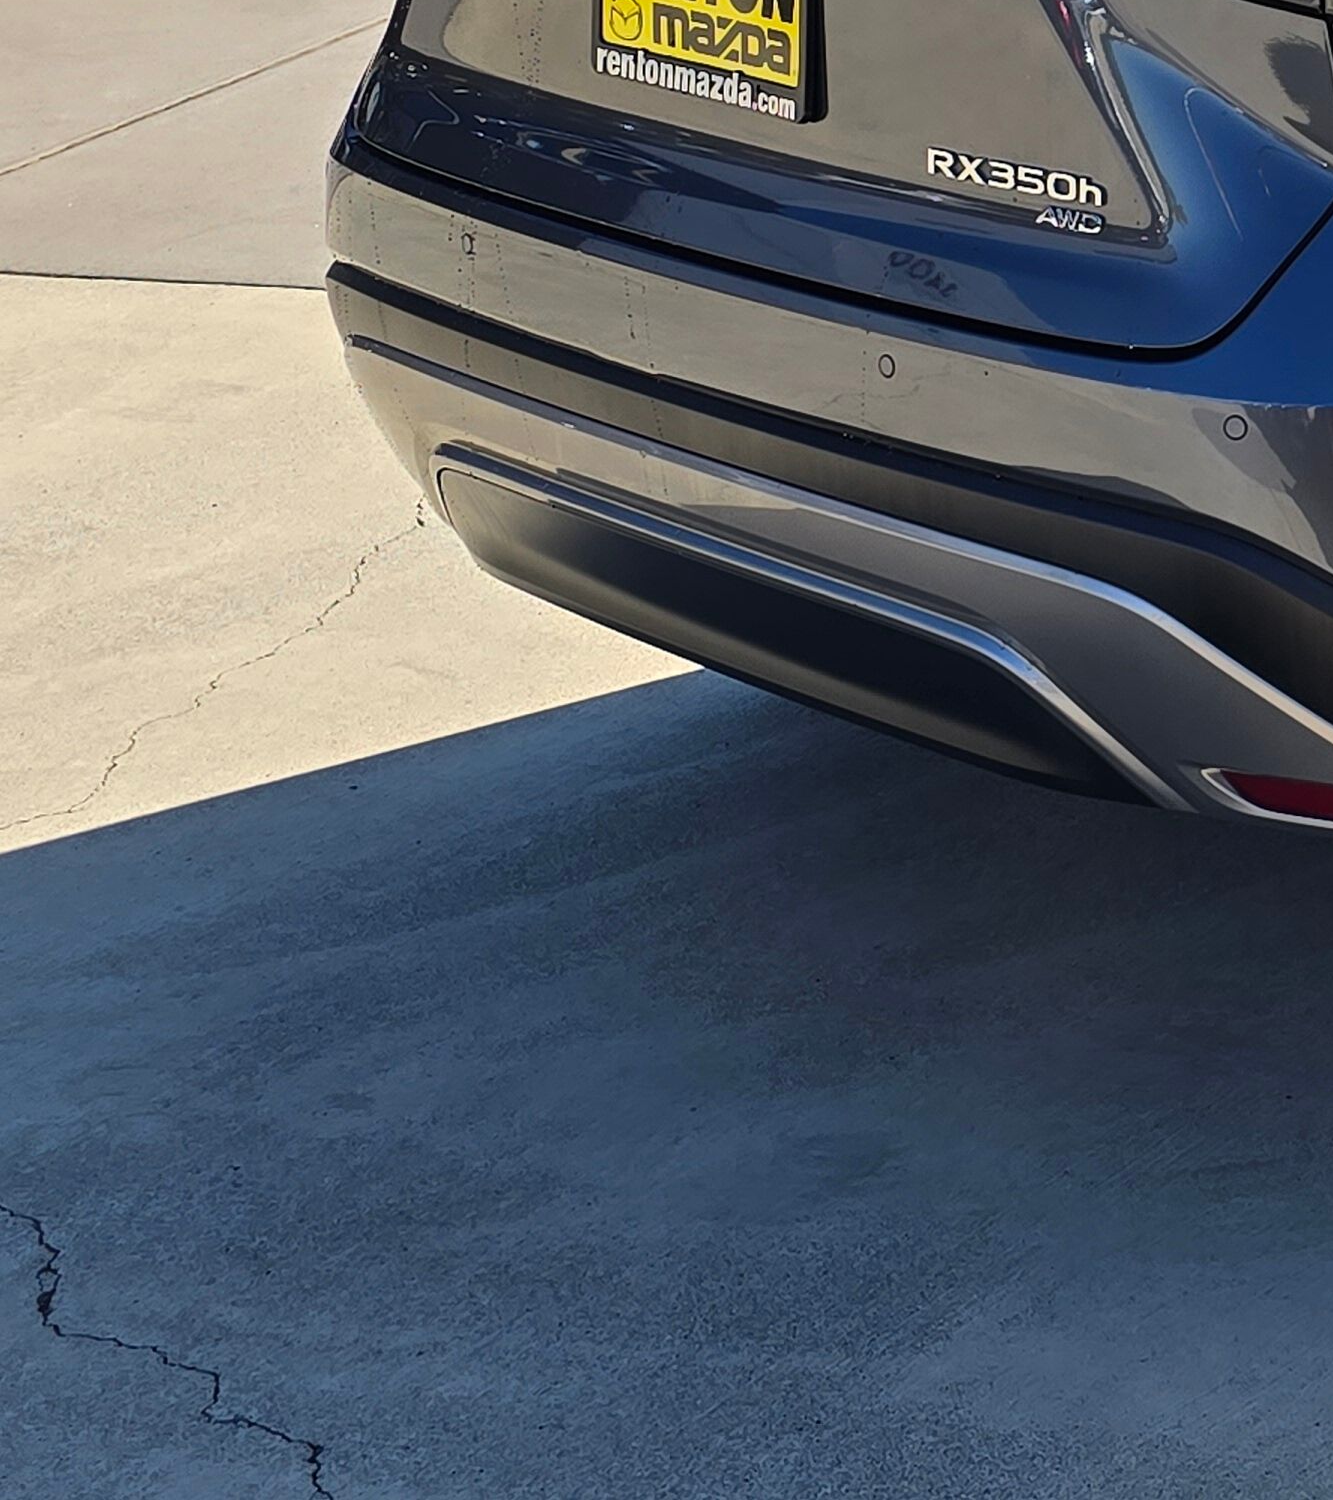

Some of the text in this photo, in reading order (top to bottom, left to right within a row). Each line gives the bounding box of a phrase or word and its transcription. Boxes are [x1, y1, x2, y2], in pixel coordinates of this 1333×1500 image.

[652, 2, 791, 76] mazda
[596, 47, 796, 120] rentonmazda.com
[927, 147, 1103, 207] RX350h
[1034, 205, 1102, 234] AWD
